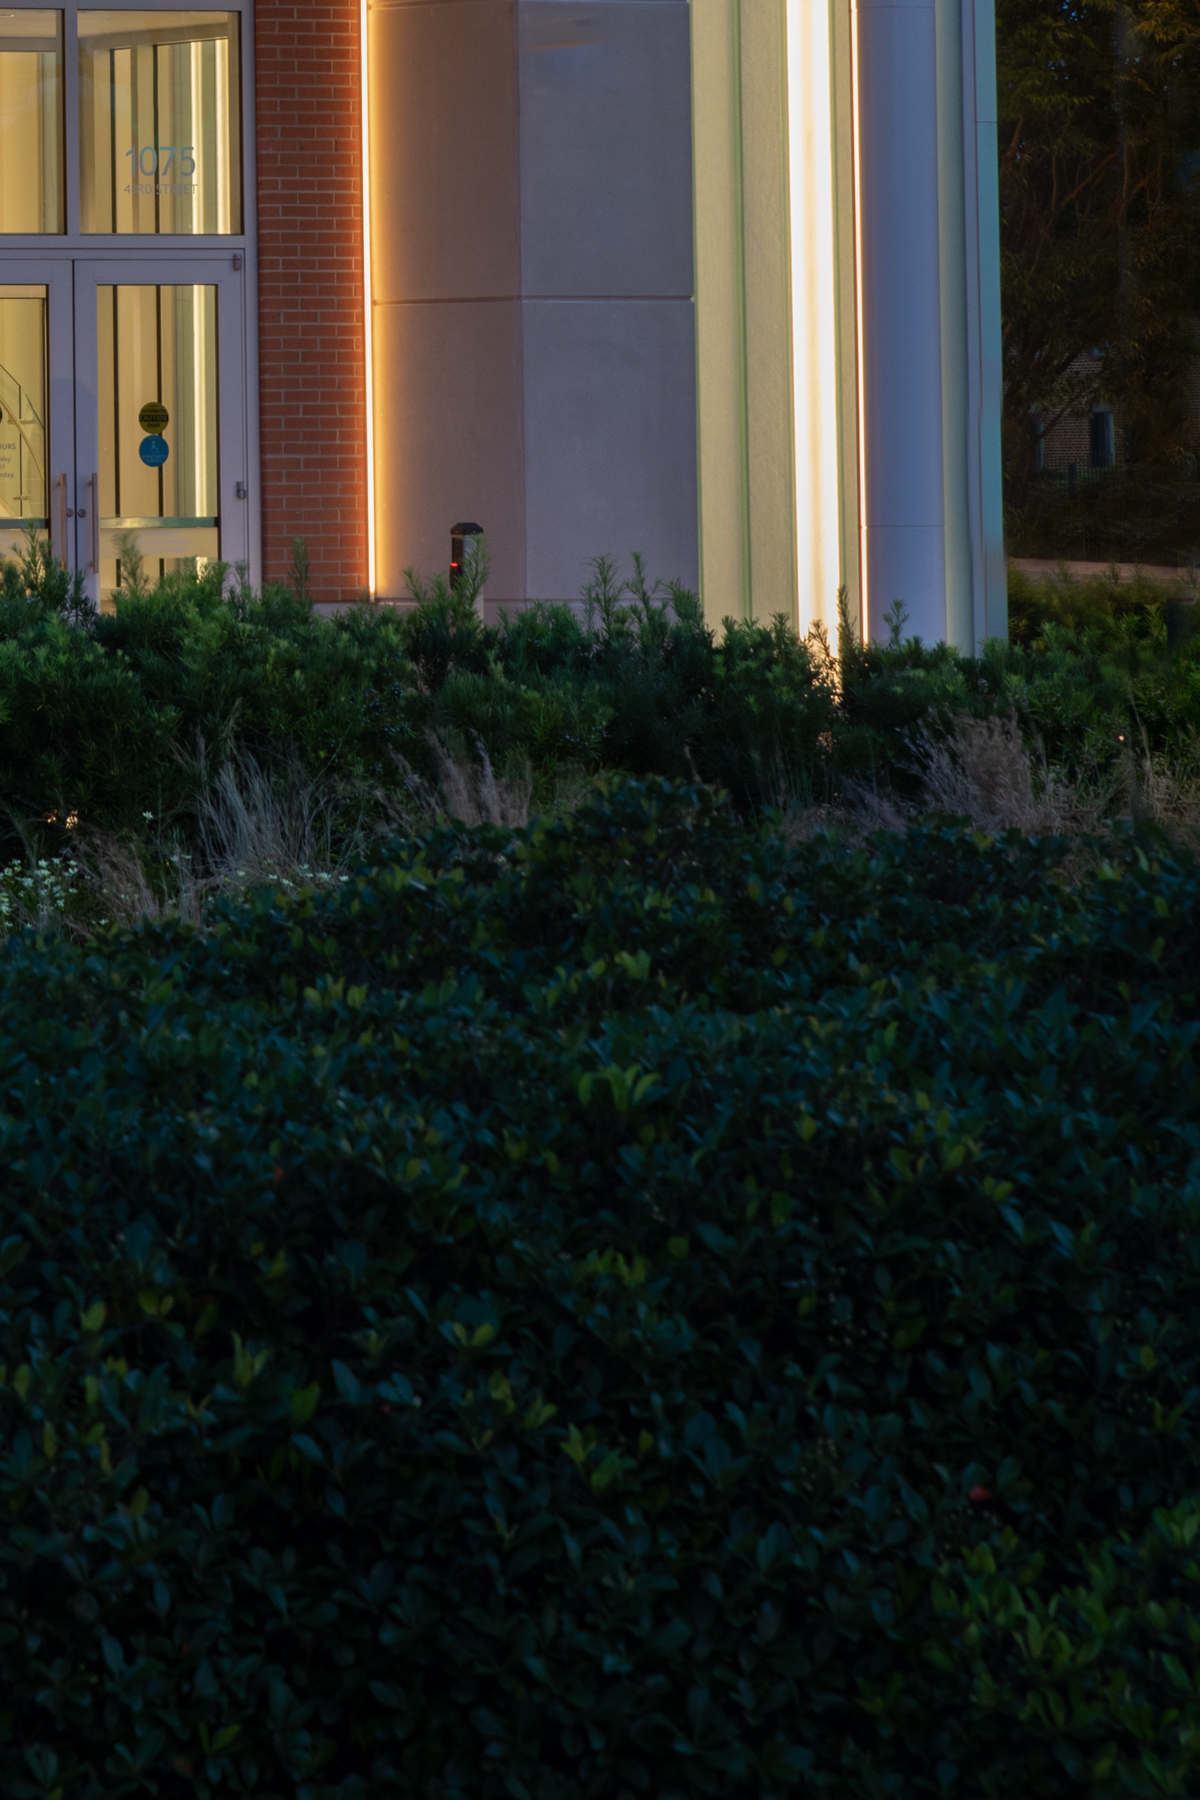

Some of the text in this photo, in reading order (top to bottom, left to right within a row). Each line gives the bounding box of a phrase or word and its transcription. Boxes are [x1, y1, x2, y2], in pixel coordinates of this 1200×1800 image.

[125, 146, 196, 177] 1075
[123, 183, 199, 195] 43RD STREET
